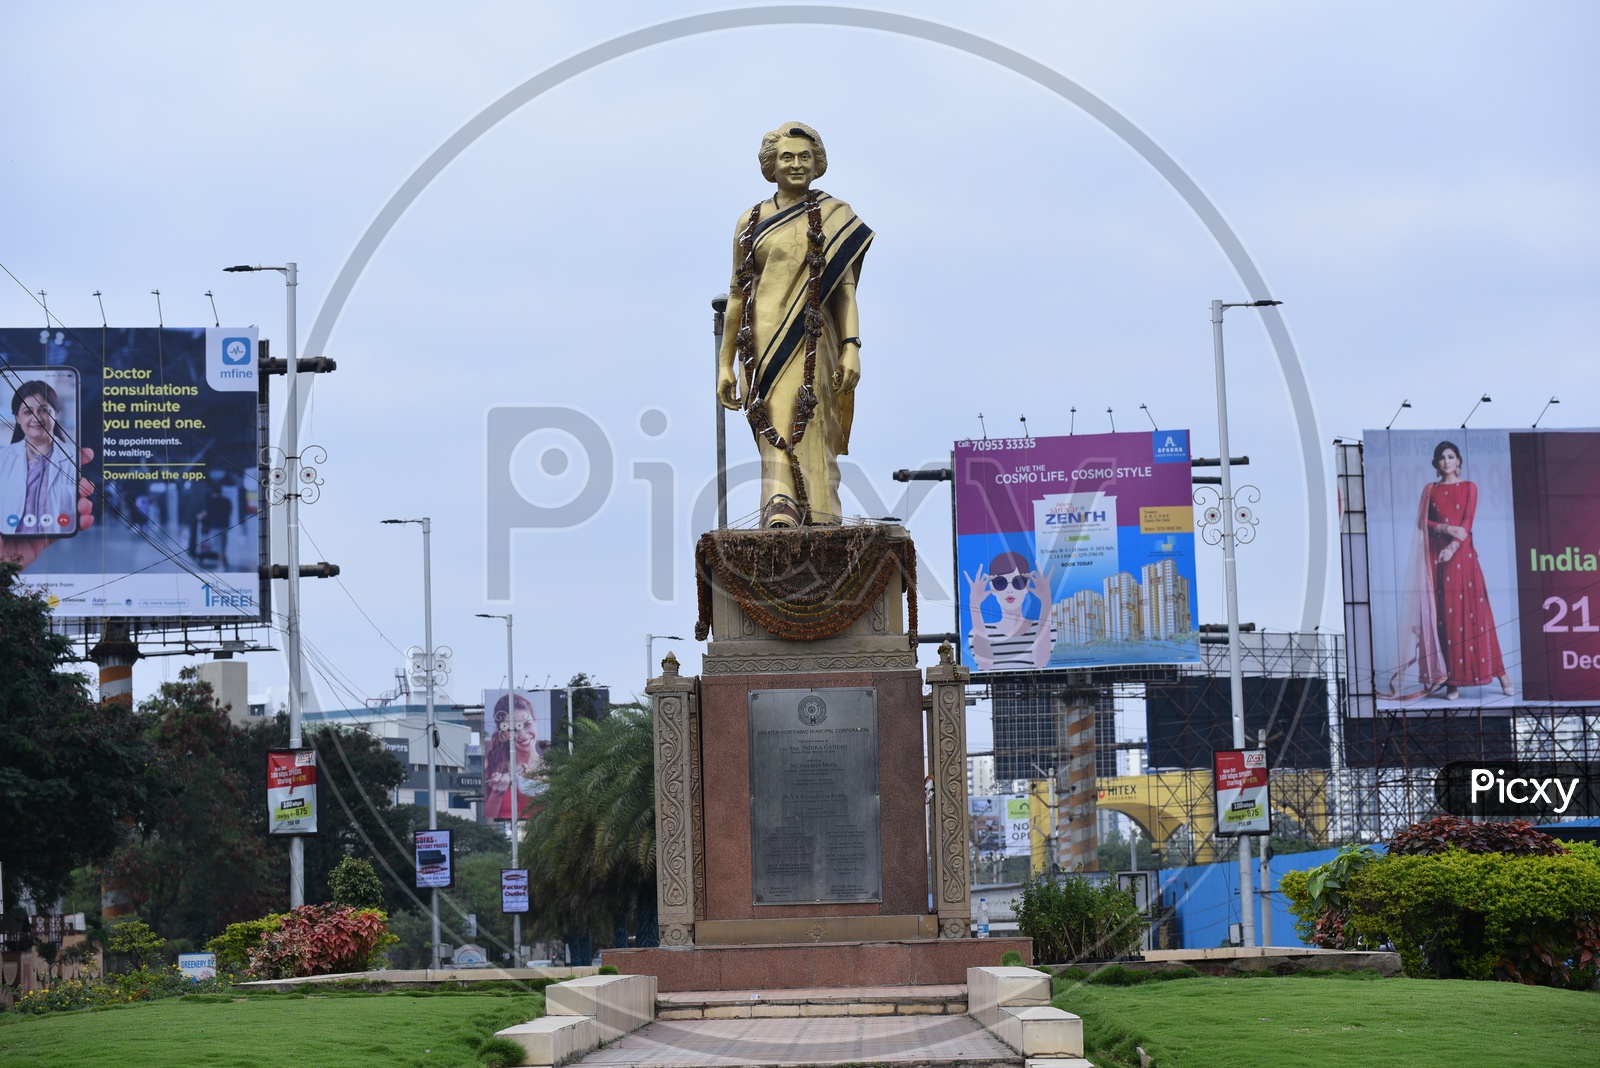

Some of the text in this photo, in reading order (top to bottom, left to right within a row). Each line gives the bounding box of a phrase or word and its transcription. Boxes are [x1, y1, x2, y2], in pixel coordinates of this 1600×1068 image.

[103, 367, 152, 380] Doctor
[220, 368, 252, 378] mfine
[103, 384, 198, 396] consultations
[102, 400, 180, 413] the minute
[104, 416, 206, 432] you need one.
[103, 438, 182, 448] No appointments.
[958, 438, 1036, 451] Call: 70953 33335
[103, 448, 154, 458] No waiting.
[103, 470, 206, 482] Download the app.
[996, 467, 1152, 484] COSMO LIFE, COSMO STYLE
[1046, 511, 1106, 525] ZENITH
[1530, 547, 1600, 571] India
[1542, 595, 1600, 632] 21
[1247, 754, 1264, 762] ACT
[1108, 785, 1136, 796] HITEX
[181, 960, 206, 968] GREENERY
